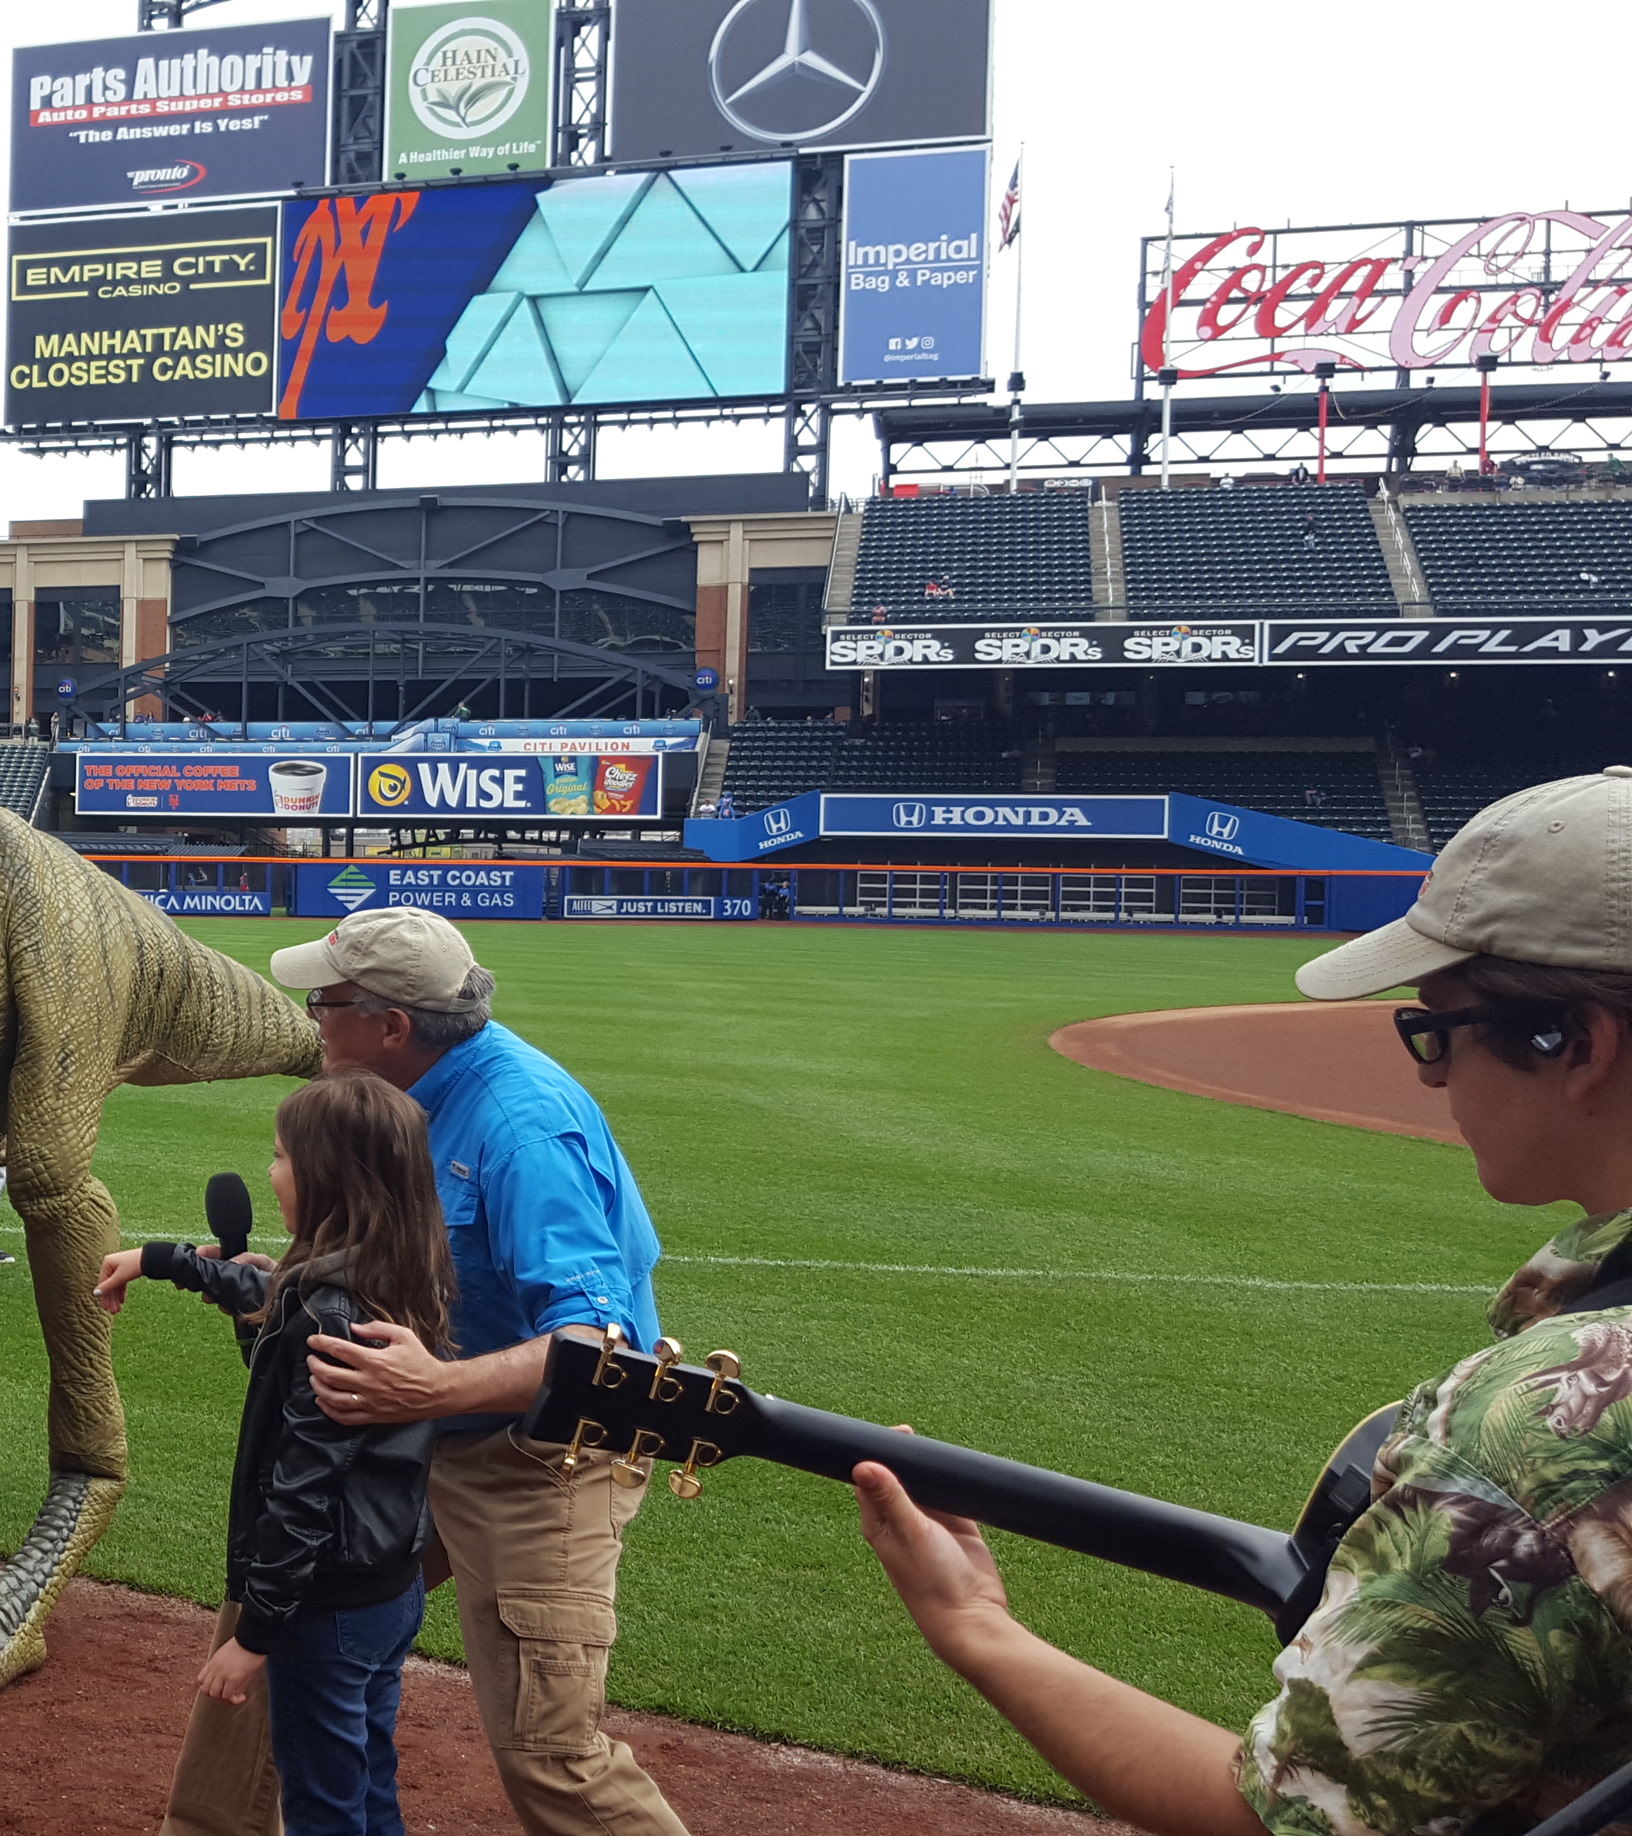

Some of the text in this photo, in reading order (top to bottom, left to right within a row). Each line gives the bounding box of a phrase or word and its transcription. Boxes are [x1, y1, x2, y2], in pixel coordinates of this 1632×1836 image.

[439, 47, 499, 68] HAIN
[29, 47, 314, 111] Parts Authority
[412, 59, 527, 88] CELESTIAL
[37, 88, 304, 124] Auto Parts Super Stores
[116, 122, 191, 140] Answer
[194, 119, 213, 134] Is
[398, 152, 407, 165] A
[409, 148, 467, 163] Healthier
[469, 146, 495, 159] Way
[497, 143, 511, 155] of
[132, 165, 189, 186] pronto
[848, 232, 978, 270] Imperial
[25, 259, 162, 287] EMPIRE
[850, 268, 978, 292] Bag & Paper
[97, 282, 181, 299] CASINO
[9, 351, 268, 390] CLOSEST CASINO
[839, 632, 932, 641] SELECT SECTOR
[984, 630, 1080, 639] SELECT SECTOR
[1133, 628, 1232, 637] SELECT SECTOR
[1271, 630, 1430, 654] PRO
[271, 725, 290, 738] citi
[479, 725, 496, 736] citi
[550, 724, 567, 736] citi
[623, 723, 641, 735] citi
[523, 741, 631, 752] CITI PAVILION
[84, 765, 240, 777] THE OFFICIAL COFFEE
[555, 762, 576, 772] WISE
[605, 766, 638, 781] Cheez
[84, 779, 257, 792] OF THE NEW YORK METS
[417, 762, 528, 809] WISE
[546, 781, 588, 795] Original
[604, 779, 635, 788] doodles
[931, 806, 1092, 826] HONDA
[758, 830, 804, 850] HONDA
[1188, 834, 1245, 856] HONDA
[388, 869, 514, 886] EAST COAST
[182, 894, 264, 911] MINOLTA
[388, 891, 515, 907] POWER & GAS
[620, 902, 706, 913] JUST LISTEN.
[722, 899, 752, 916] 370
